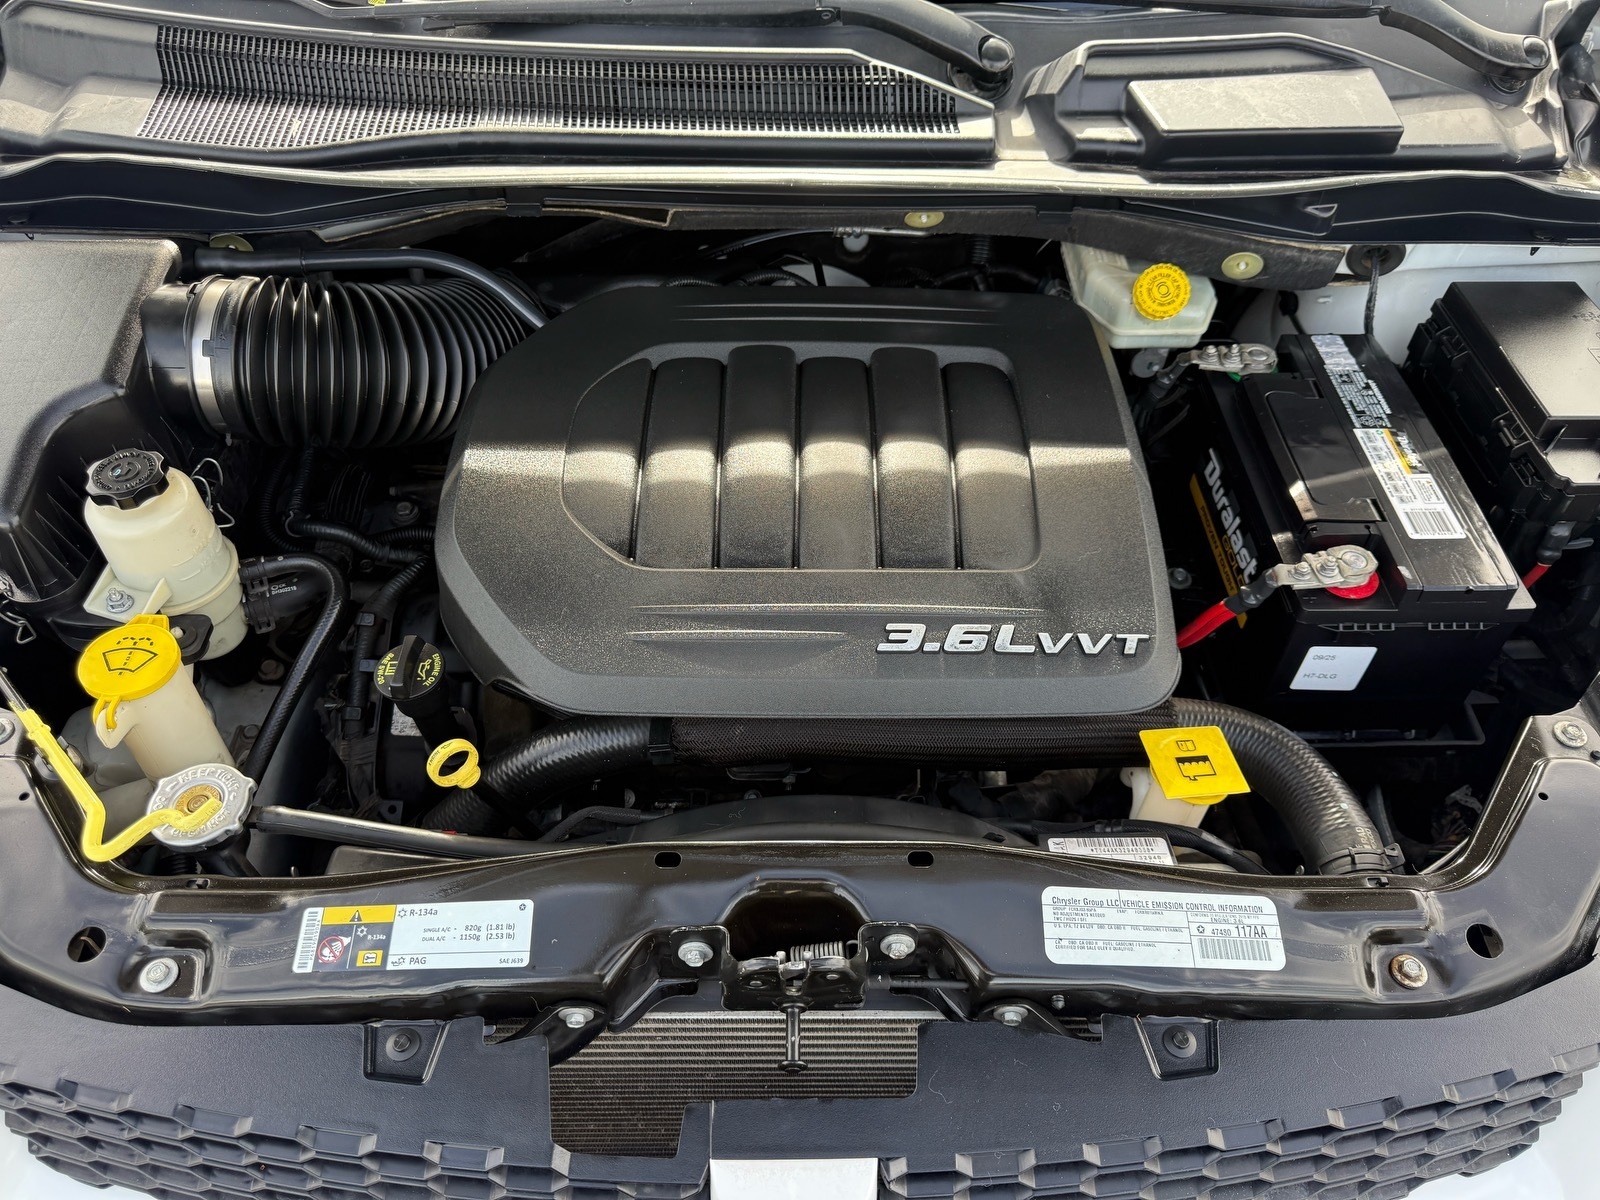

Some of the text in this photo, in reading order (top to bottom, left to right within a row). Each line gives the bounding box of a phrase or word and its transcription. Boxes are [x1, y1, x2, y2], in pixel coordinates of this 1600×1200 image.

[1203, 448, 1258, 584] Duralast
[1199, 505, 1235, 592] PROVEN TOUGH
[877, 623, 1150, 655] 3.6L VVT
[377, 652, 395, 685] SAE 5W-20
[422, 653, 442, 686] ENGINE OIL
[178, 767, 216, 785] KEEP
[409, 908, 438, 917] R-134a
[1052, 896, 1264, 913] Chrysler Group LLC VEHICLE EMISSION CONTROL INFORMATION
[464, 924, 482, 932] 820g
[486, 923, 504, 931] (1.81
[505, 922, 516, 931] lb)
[1235, 925, 1267, 938] 117AA
[459, 934, 481, 942] 1150g
[485, 933, 504, 941] (2.53
[505, 932, 515, 940] lb)
[408, 956, 427, 965] PAG
